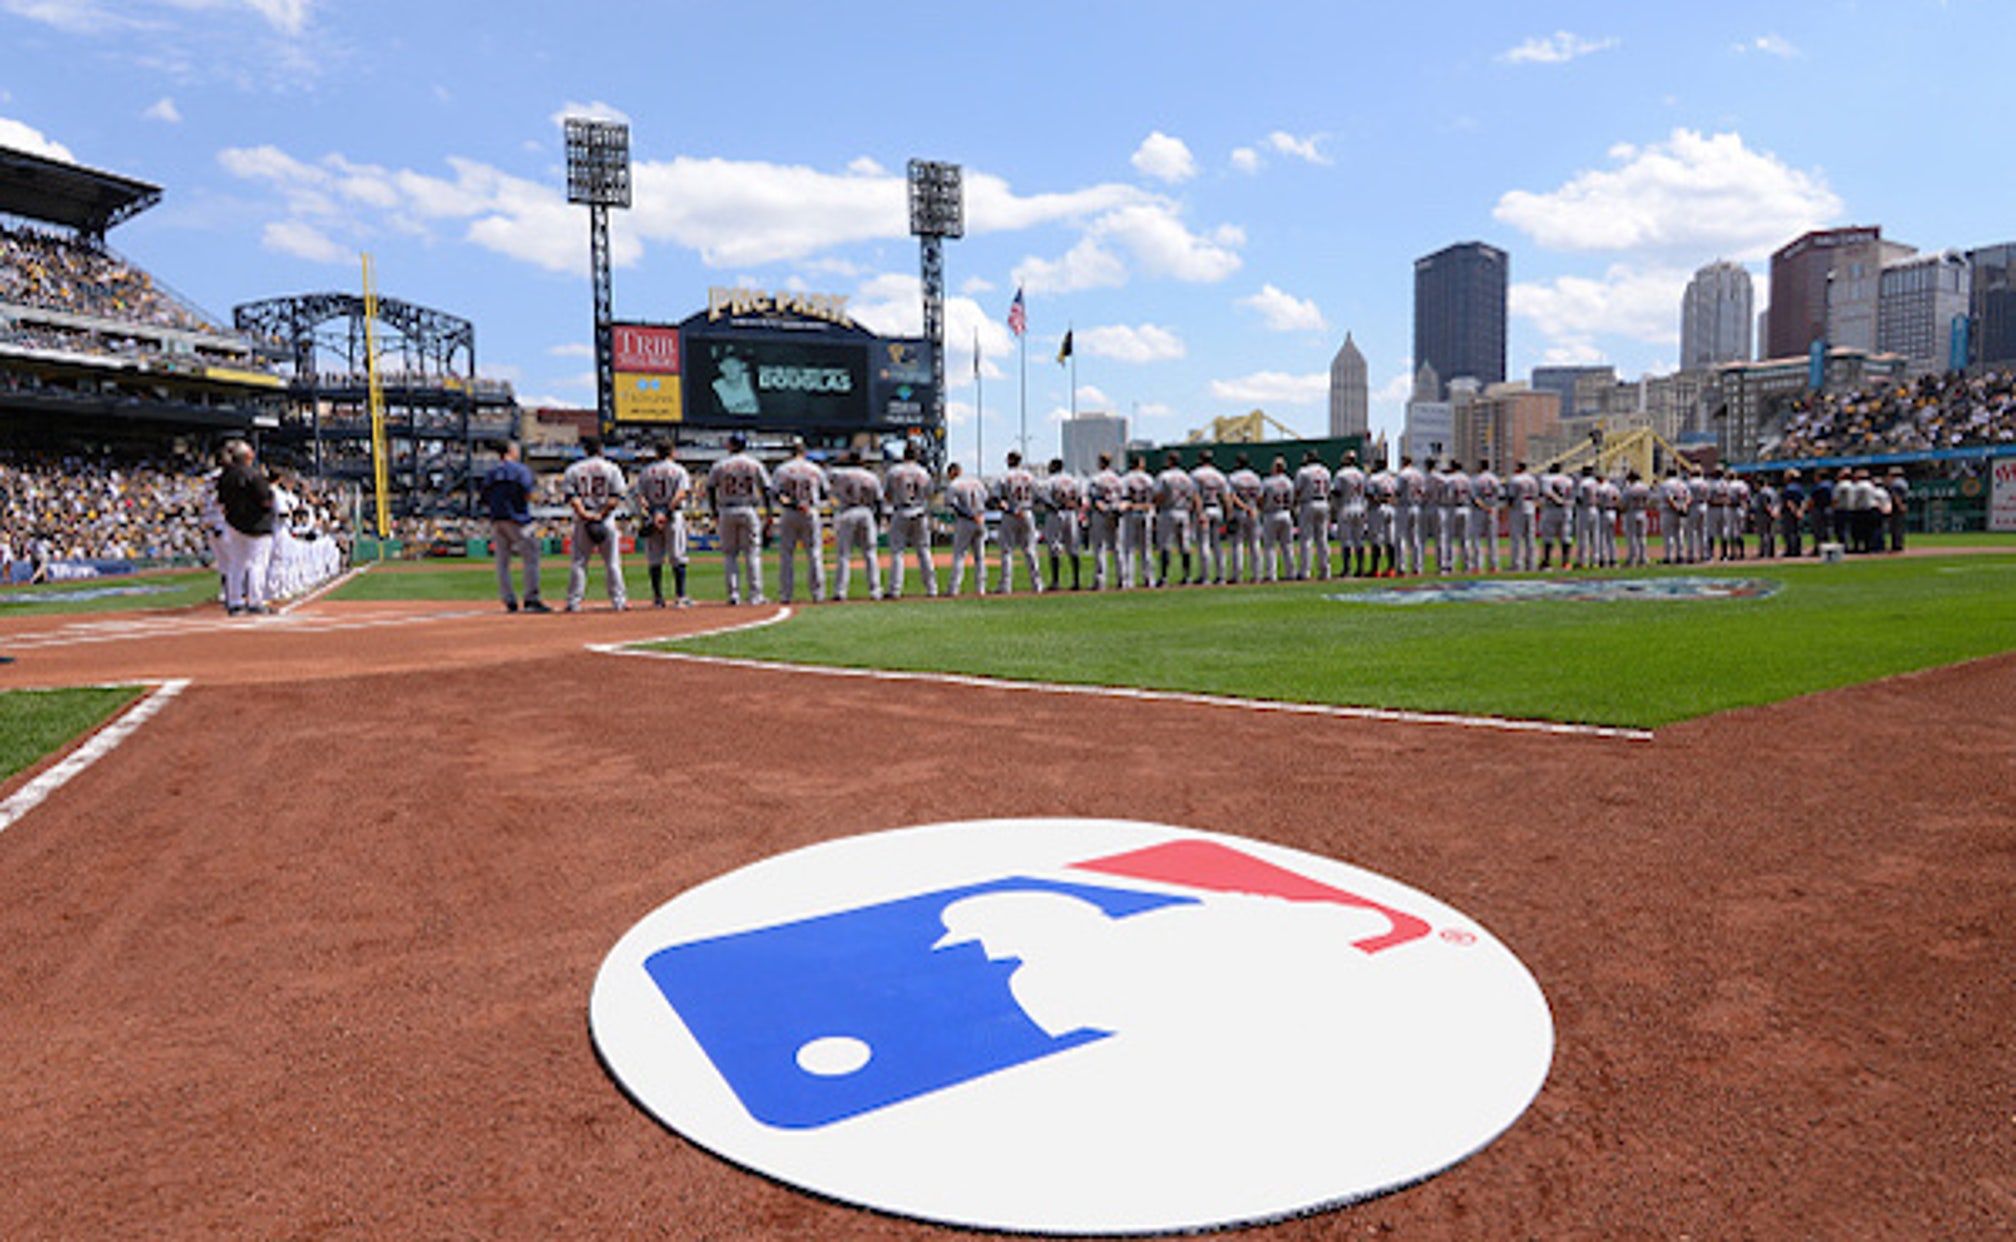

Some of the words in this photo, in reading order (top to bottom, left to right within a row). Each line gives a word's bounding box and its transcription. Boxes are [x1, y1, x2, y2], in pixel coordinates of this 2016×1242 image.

[708, 286, 770, 323] PNC
[774, 289, 854, 330] PARK
[618, 329, 676, 357] TRIB
